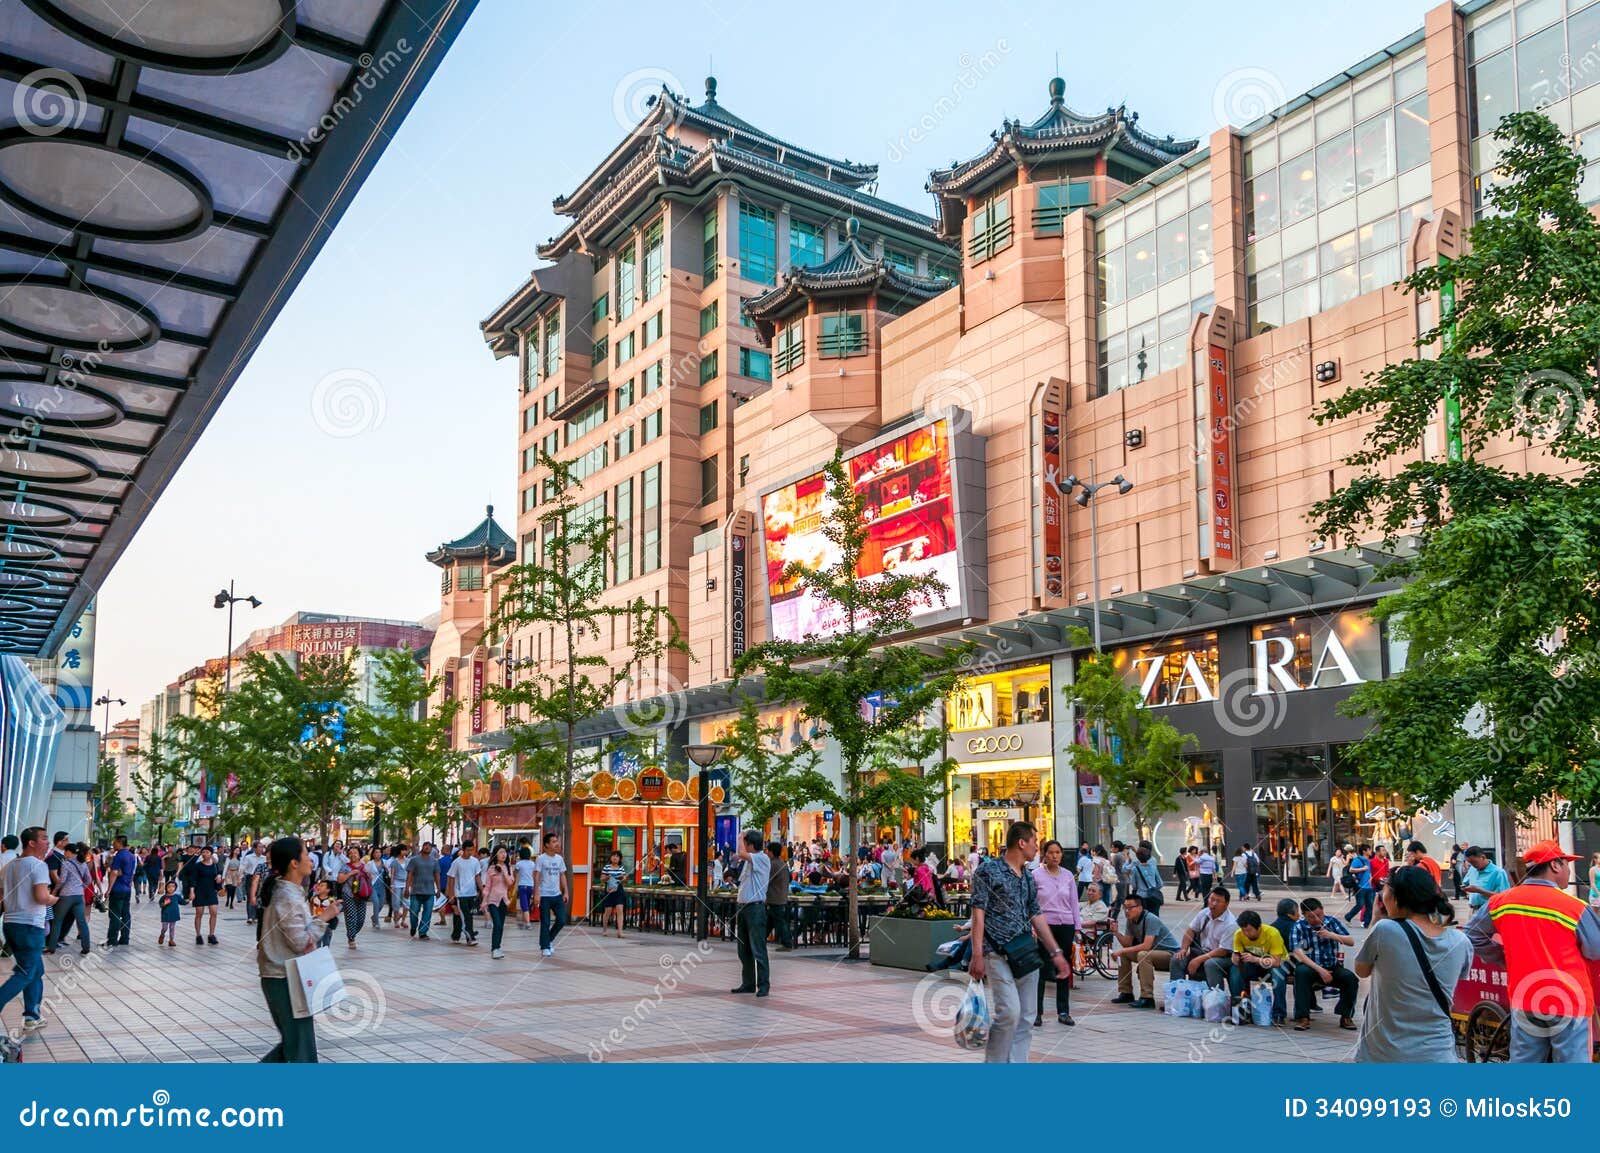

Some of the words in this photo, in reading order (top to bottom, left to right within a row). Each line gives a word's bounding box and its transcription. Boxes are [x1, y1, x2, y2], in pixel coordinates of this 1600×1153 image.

[733, 564, 744, 608] PACIFIC
[733, 611, 745, 656] COFFEE
[300, 640, 345, 653] INTIME
[1132, 629, 1367, 710] ZARA
[473, 706, 481, 729] COSTA
[966, 733, 1024, 755] G2000
[1251, 785, 1303, 803] ZARA
